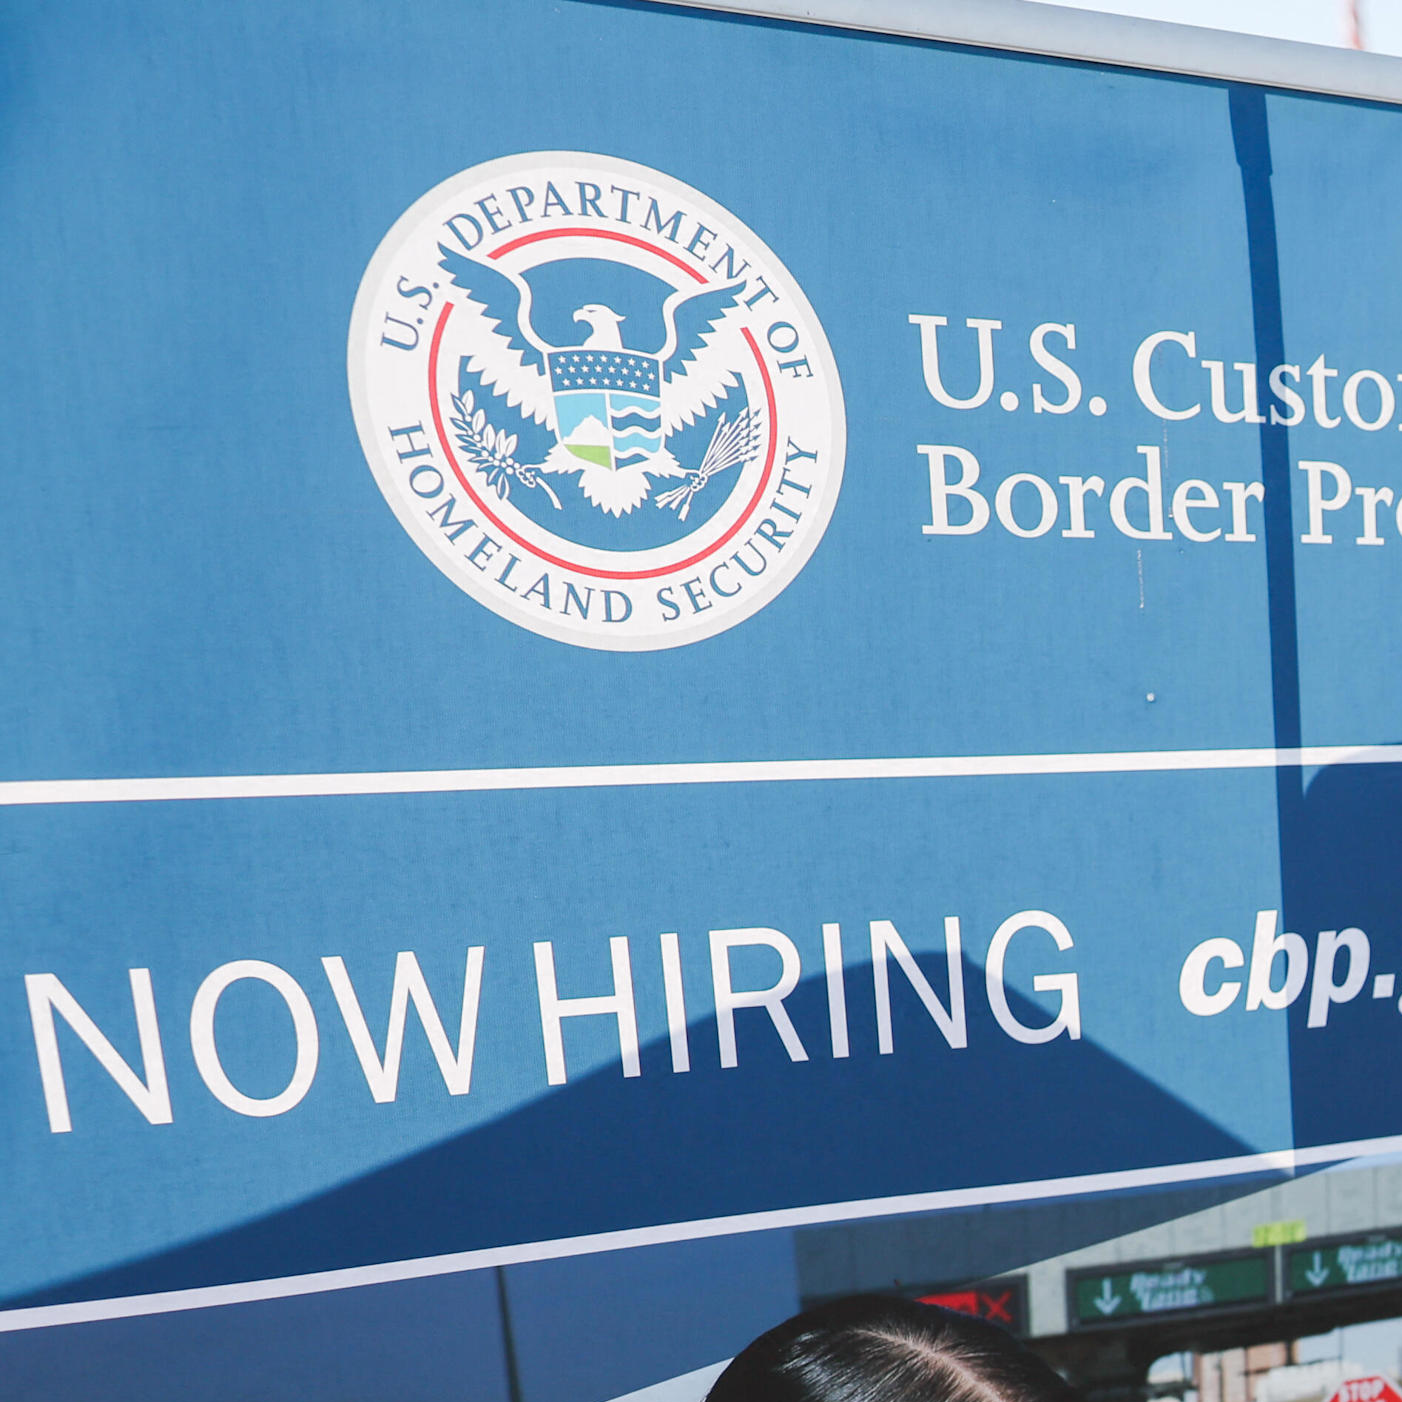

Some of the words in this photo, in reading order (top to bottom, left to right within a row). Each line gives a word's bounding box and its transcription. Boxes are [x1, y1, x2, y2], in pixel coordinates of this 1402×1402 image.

[380, 276, 440, 352] U.S.
[443, 181, 779, 311] DEPARTMENT
[766, 320, 814, 380] OF
[908, 314, 1106, 416] U.S.
[388, 420, 633, 623] HOMELAND
[656, 435, 818, 621] SECURITY
[916, 444, 1265, 543] Border
[23, 945, 489, 1133] NOW
[534, 909, 1081, 1085] HIRING
